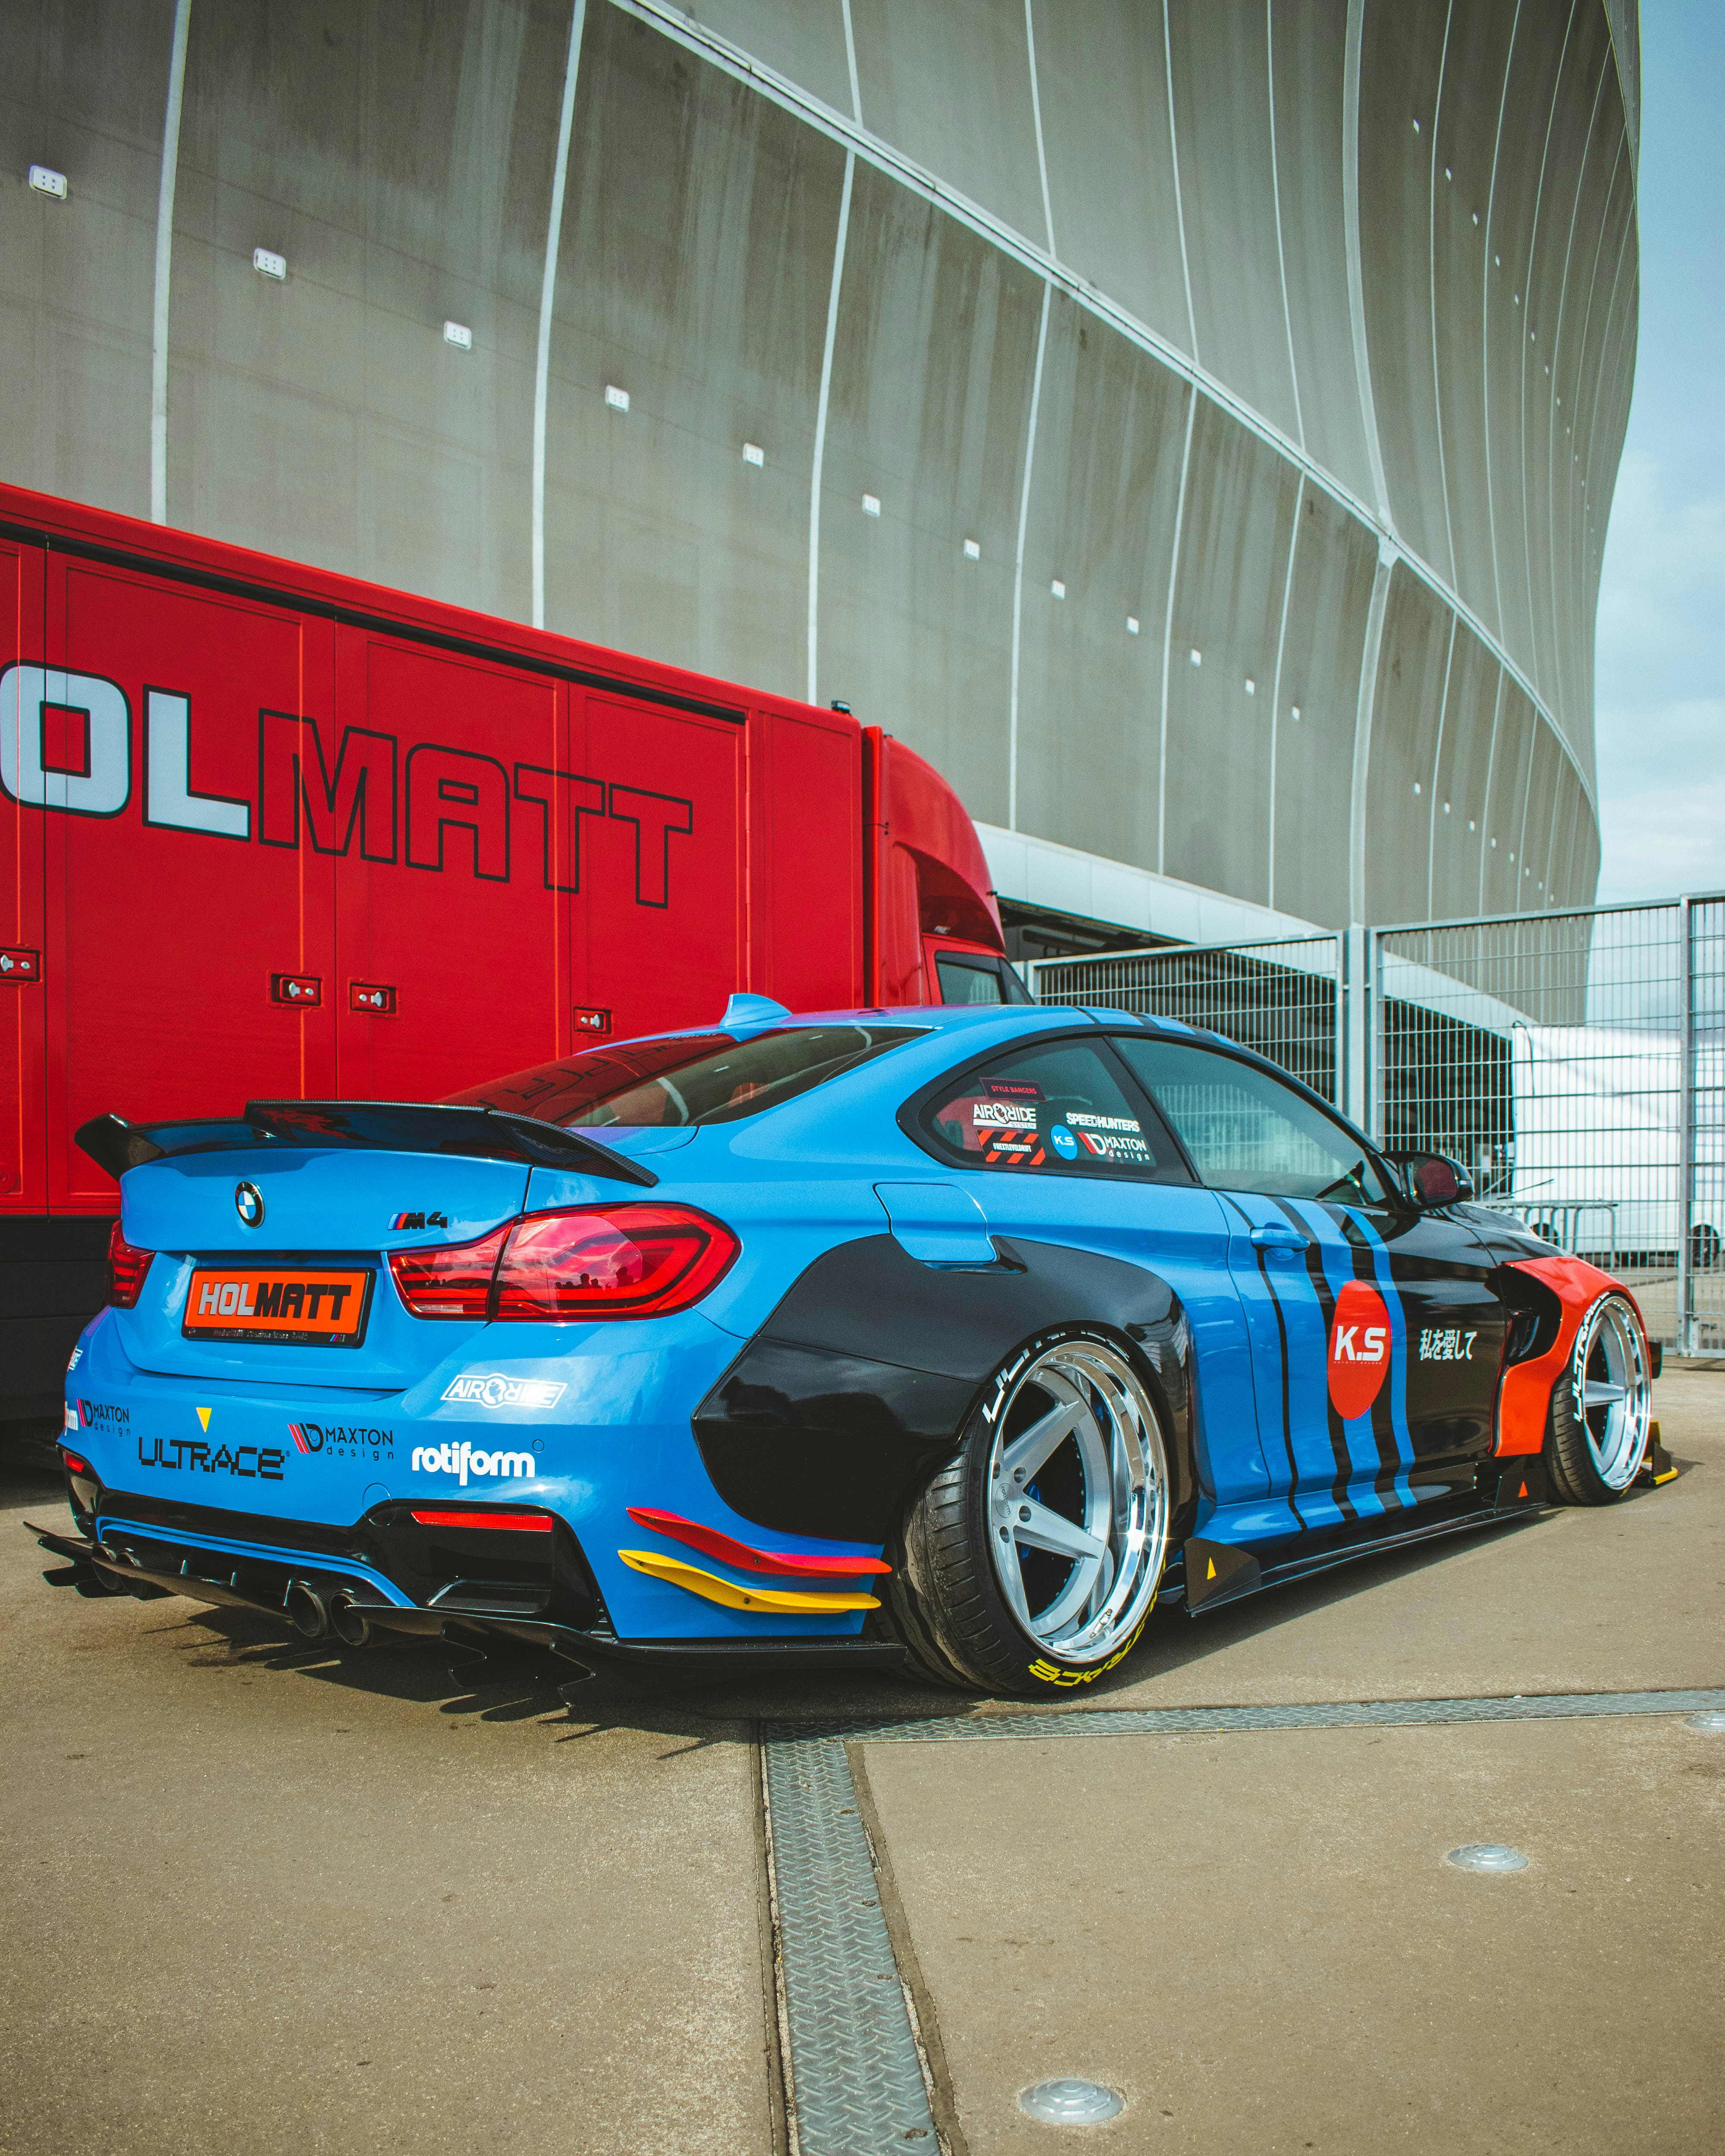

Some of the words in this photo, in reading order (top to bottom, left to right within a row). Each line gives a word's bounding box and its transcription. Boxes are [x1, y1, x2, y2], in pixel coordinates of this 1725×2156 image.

[1103, 1136, 1147, 1151] MAXTON
[1108, 1149, 1150, 1162] design
[402, 1211, 448, 1229] M4
[198, 1282, 352, 1320] HOLMATT
[1418, 1328, 1478, 1361] 私を愛して
[93, 1403, 129, 1423] MAXTON
[94, 1422, 131, 1437] design
[326, 1426, 393, 1446] MAXTON
[138, 1437, 285, 1481] ULTRACE
[326, 1445, 394, 1461] design
[412, 1441, 535, 1486] rotiform
